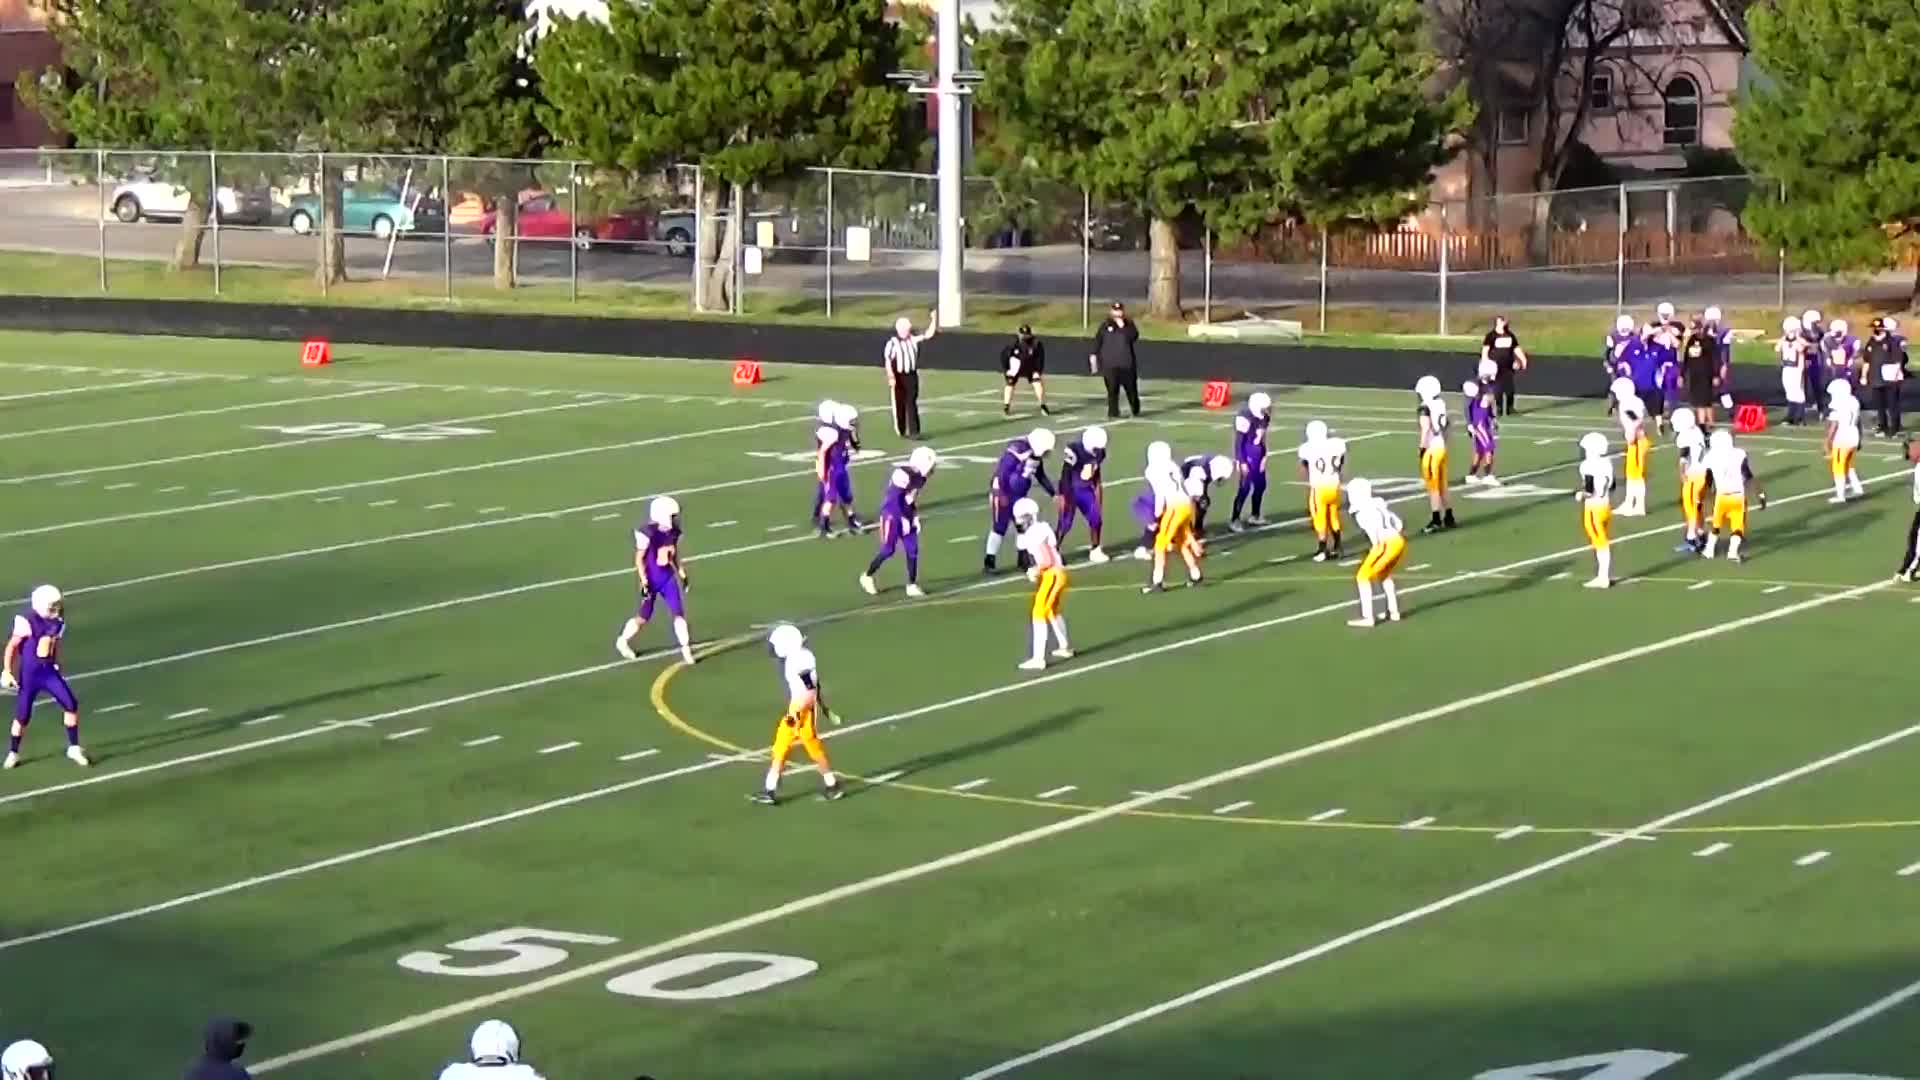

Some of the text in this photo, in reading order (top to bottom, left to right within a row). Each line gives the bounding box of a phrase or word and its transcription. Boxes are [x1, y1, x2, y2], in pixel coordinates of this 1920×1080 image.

[306, 344, 320, 361] 10
[736, 363, 754, 379] 20
[1207, 383, 1224, 402] 30
[1738, 406, 1759, 427] 40
[397, 926, 819, 999] 50
